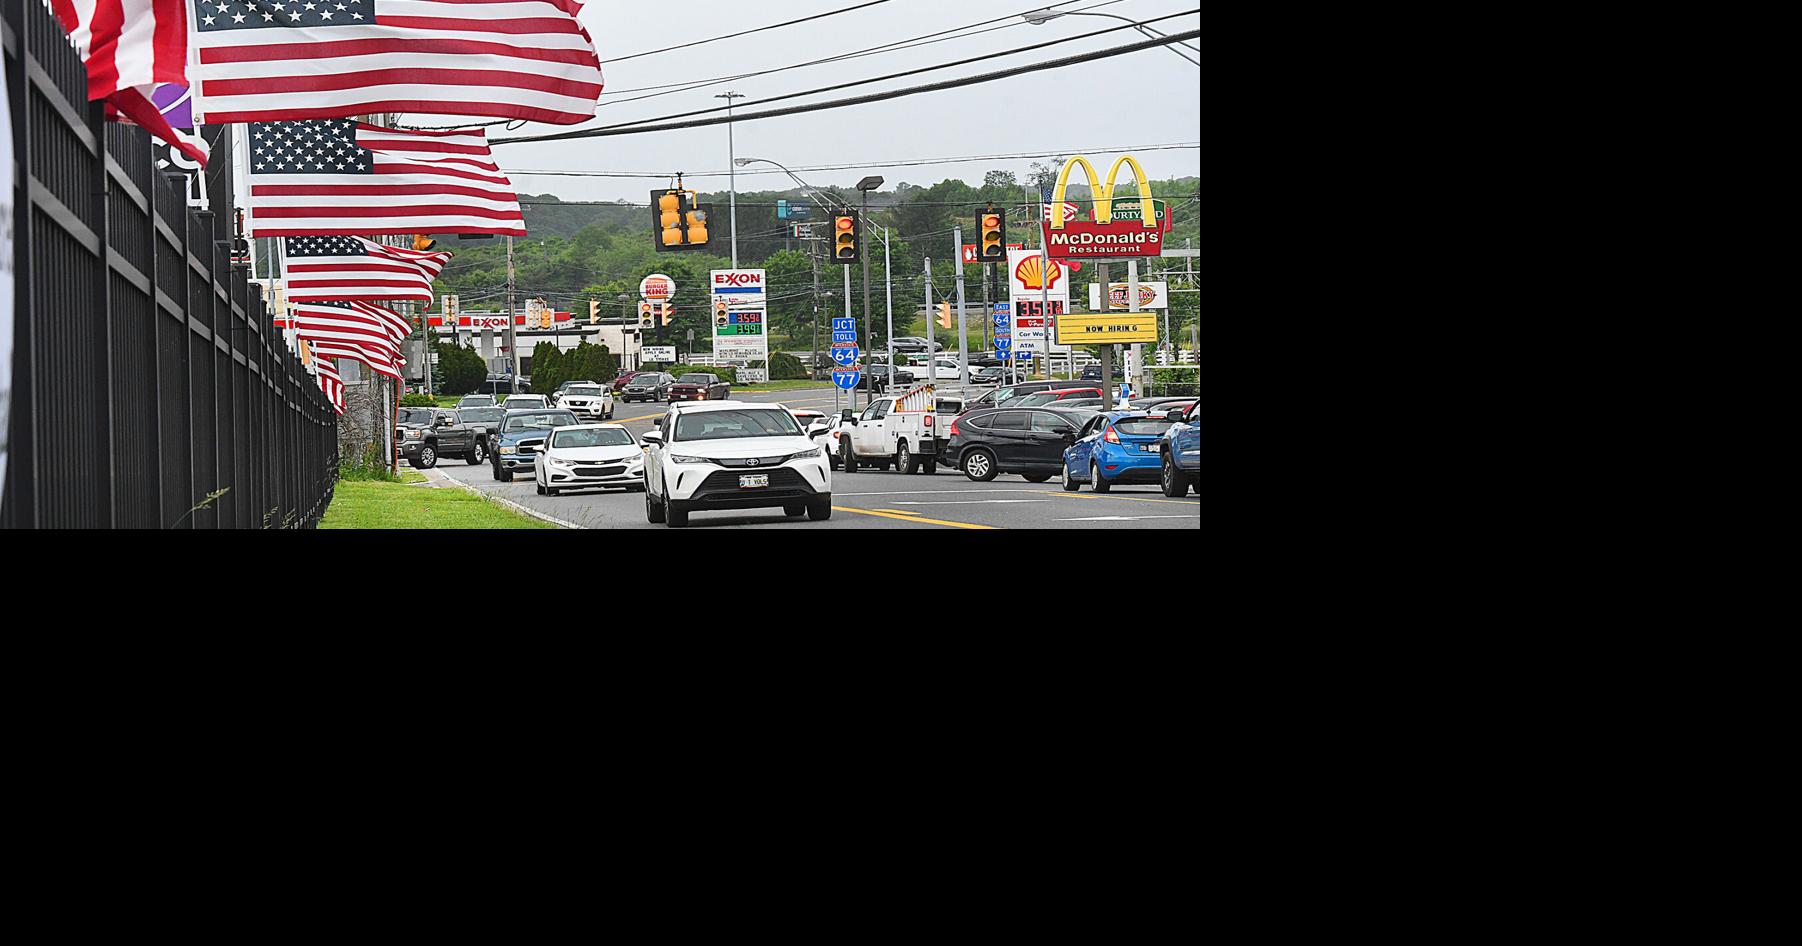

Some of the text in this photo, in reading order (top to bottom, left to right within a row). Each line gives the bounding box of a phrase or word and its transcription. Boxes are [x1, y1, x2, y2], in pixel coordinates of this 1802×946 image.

[1050, 231, 1159, 245] McDonald's
[1068, 245, 1141, 254] Restaurant
[715, 273, 761, 287] EXXON
[473, 318, 508, 329] EXXON
[835, 320, 854, 330] JCT
[996, 316, 1009, 324] 64
[835, 333, 854, 341] TOLL
[996, 339, 1010, 348] 77
[835, 350, 855, 361] 64
[836, 374, 855, 385] 77
